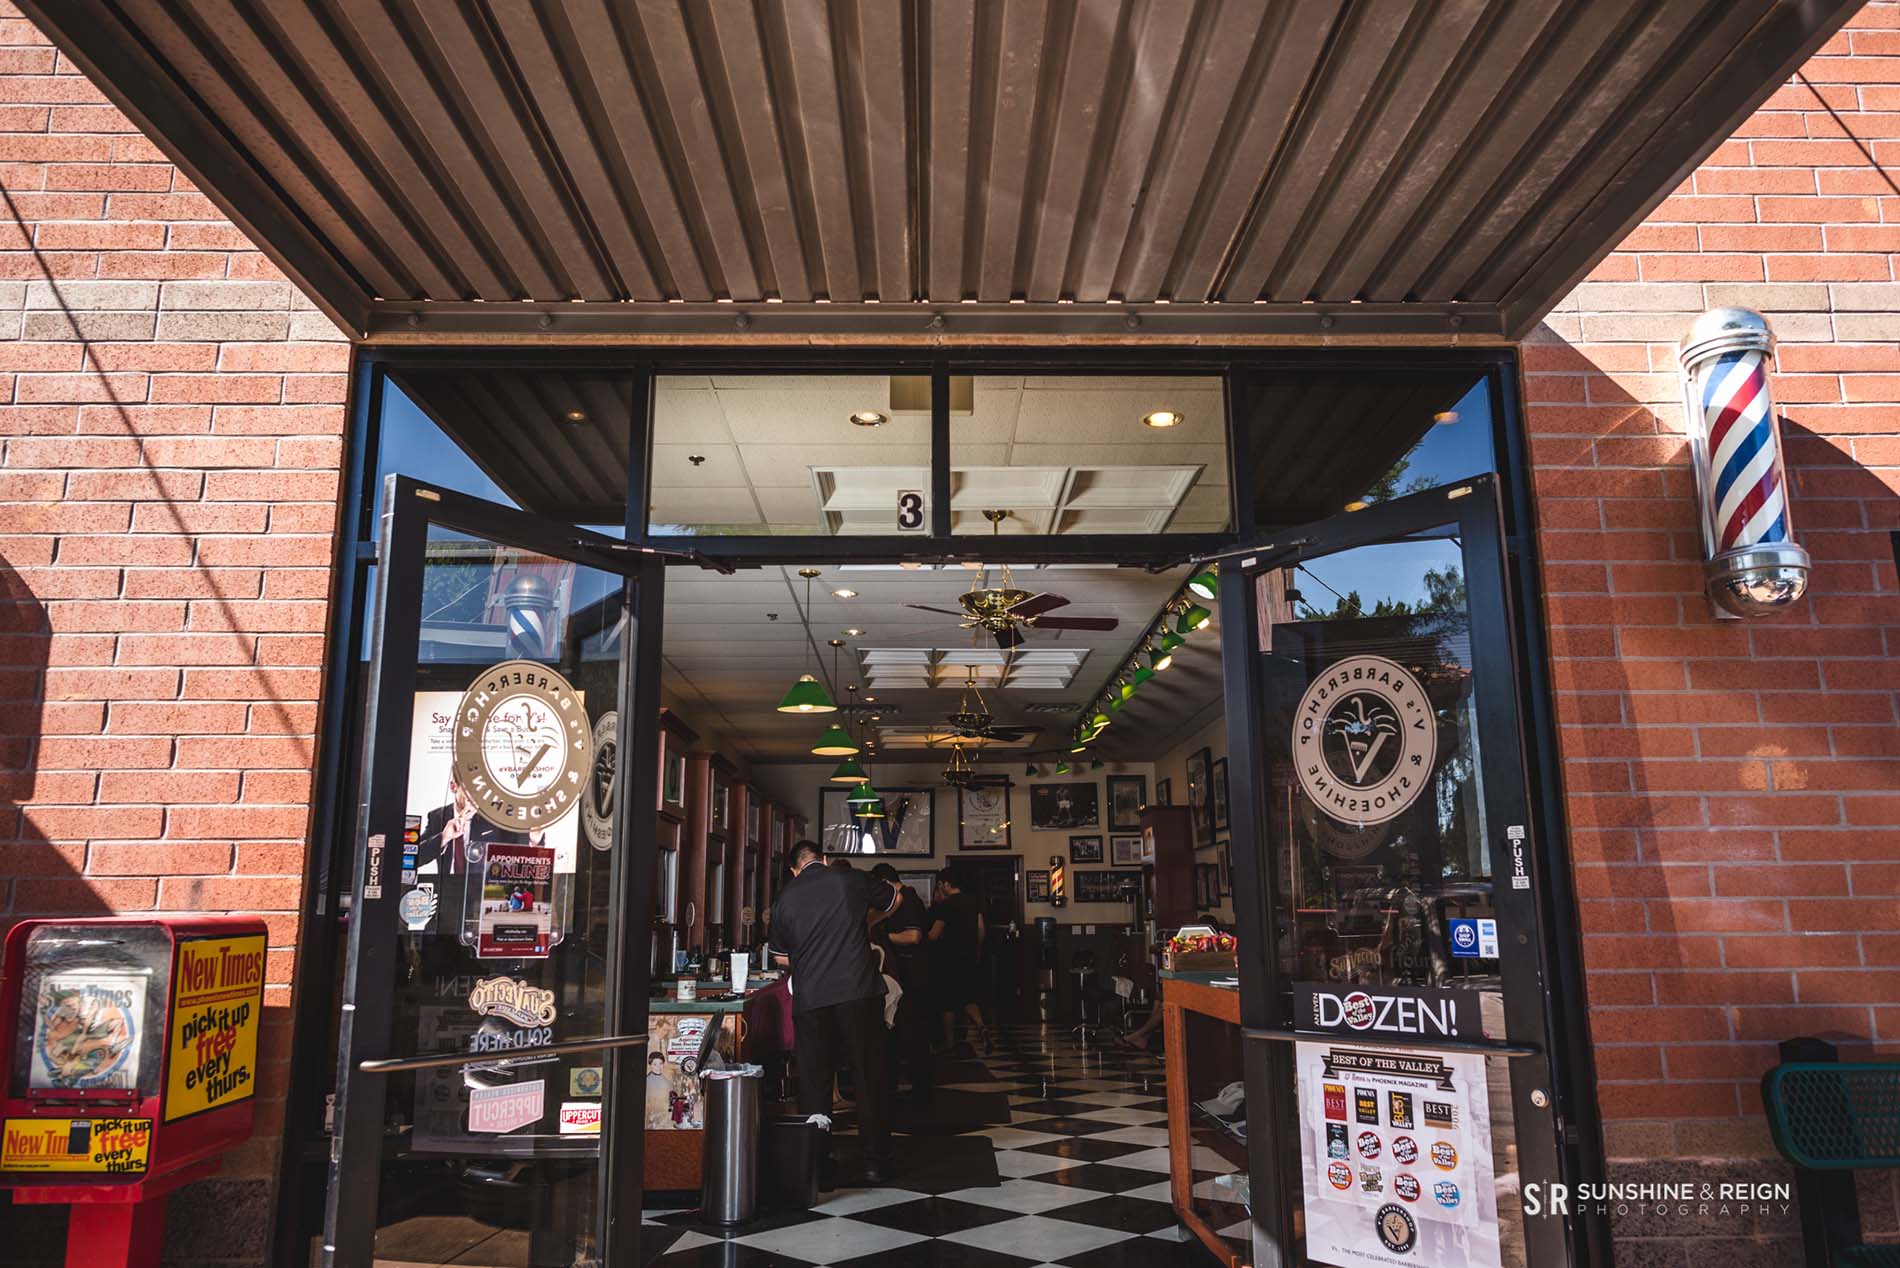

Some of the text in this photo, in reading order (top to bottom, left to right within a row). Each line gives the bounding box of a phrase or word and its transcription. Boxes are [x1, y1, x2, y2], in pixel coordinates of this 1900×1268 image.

[899, 494, 923, 528] 3
[432, 712, 451, 727] Say
[490, 855, 551, 865] APPOINTMENTS
[1513, 839, 1524, 876] PUSH
[369, 848, 381, 886] PUSH
[180, 946, 262, 993] New Times
[1312, 992, 1321, 1026] AN EVEN
[1343, 996, 1370, 1012] Best
[1318, 991, 1459, 1036] DOZEN!
[1347, 1012, 1373, 1025] Valley
[182, 1002, 250, 1049] pick it up
[196, 1023, 237, 1067] free
[185, 1049, 231, 1090] every
[1332, 1054, 1440, 1074] BEST OF THE VALLEY
[205, 1064, 251, 1104] thurs.
[1372, 1078, 1398, 1086] PHOENIX
[1399, 1080, 1429, 1089] MAGAZINE
[1326, 1097, 1345, 1110] BEST
[1392, 1092, 1404, 1123] BEST
[1425, 1103, 1450, 1115] BEST
[562, 1109, 601, 1122] UPPERCUT
[94, 1119, 151, 1136] pick it up
[6, 1130, 44, 1155] New
[99, 1128, 147, 1153] free
[1358, 1133, 1378, 1146] Best
[1392, 1140, 1415, 1152] Best
[94, 1147, 133, 1163] every
[1431, 1144, 1454, 1157] Best
[106, 1157, 148, 1174] thurs.
[1329, 1165, 1349, 1176] Best
